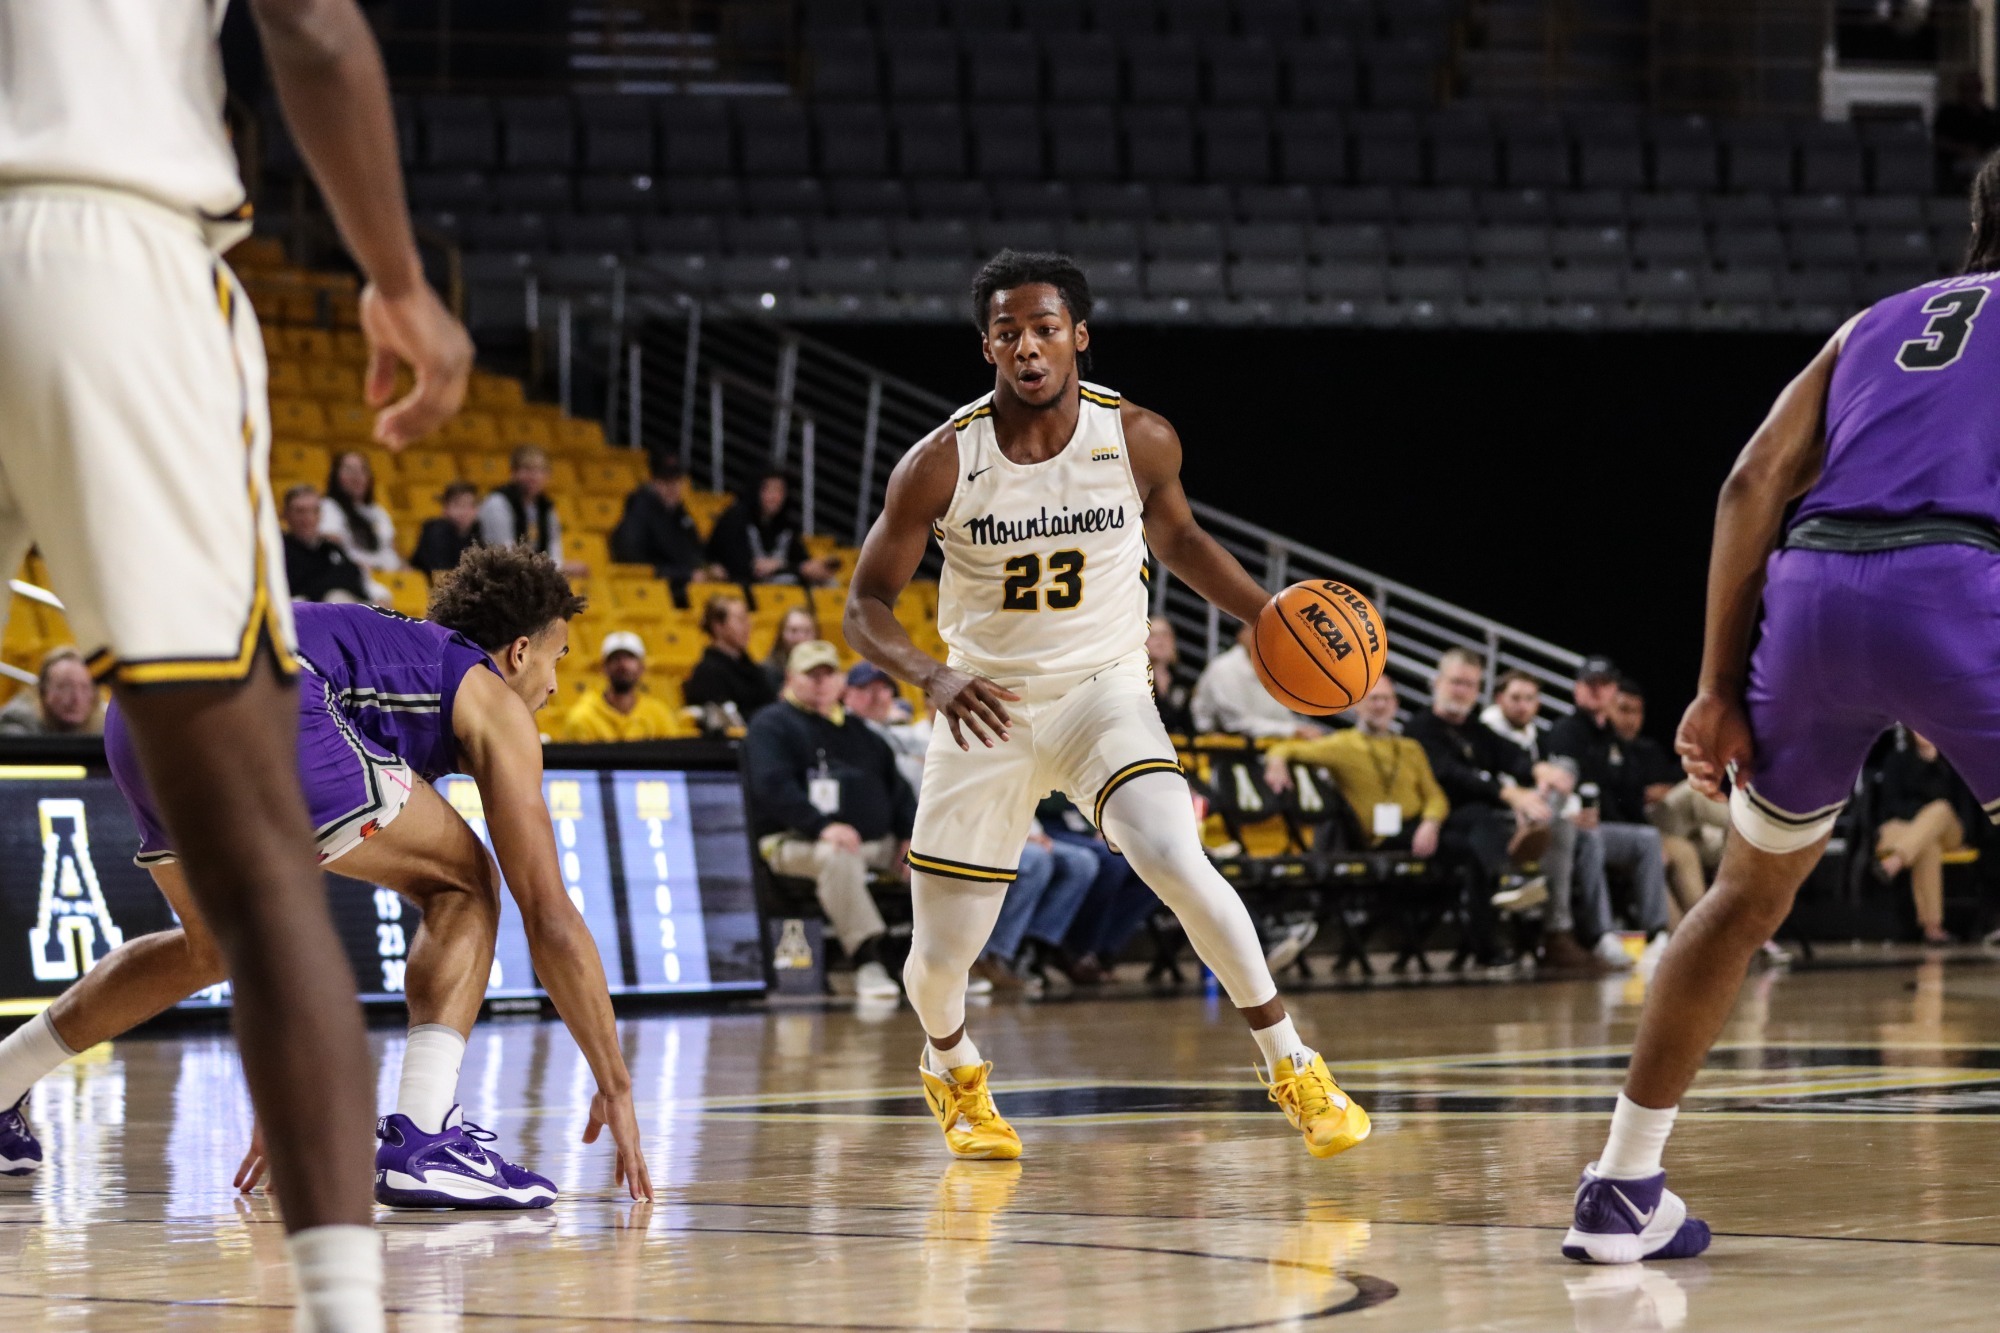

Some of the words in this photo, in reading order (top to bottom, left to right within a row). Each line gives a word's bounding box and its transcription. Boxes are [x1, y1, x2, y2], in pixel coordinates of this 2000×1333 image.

[1894, 286, 1991, 372] 3
[1091, 446, 1119, 462] SBC
[963, 505, 1125, 545] Mountaineers
[1002, 547, 1087, 612] 23
[1300, 602, 1353, 661] NCAA
[1322, 581, 1380, 654] Wilson
[647, 816, 664, 848] 2
[654, 851, 668, 881] 1
[376, 922, 406, 956] 23
[660, 917, 677, 949] 2
